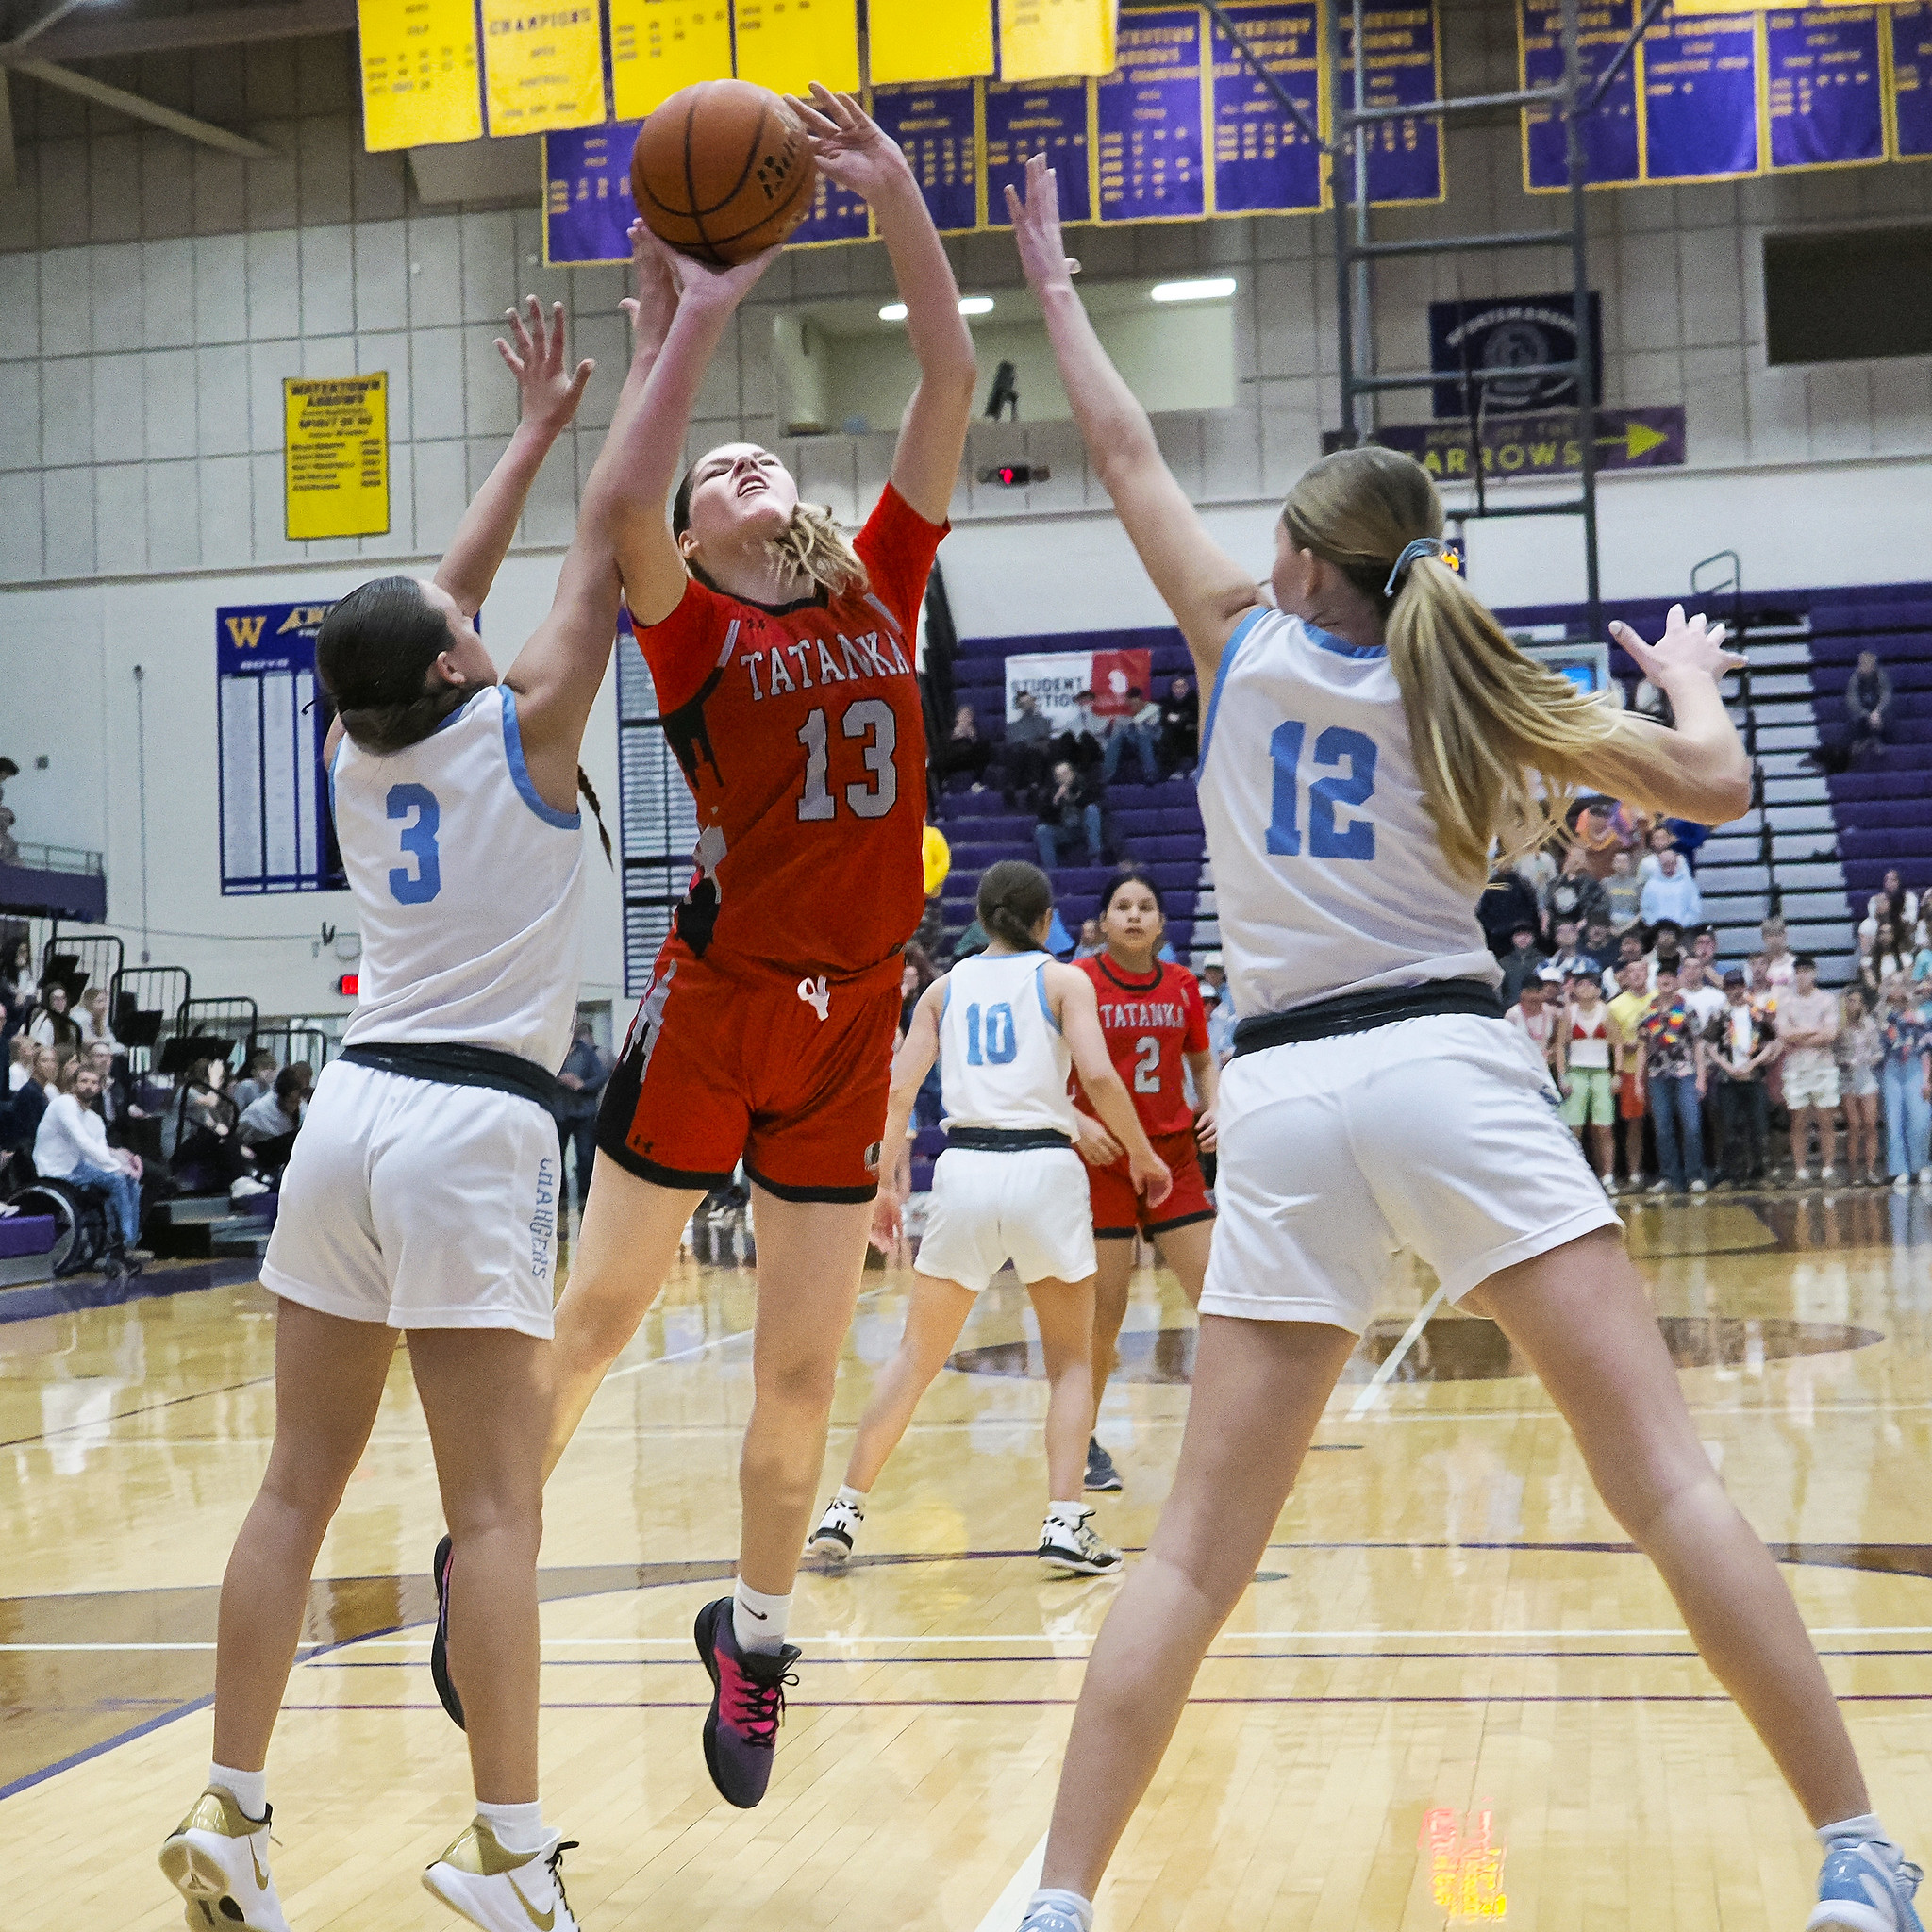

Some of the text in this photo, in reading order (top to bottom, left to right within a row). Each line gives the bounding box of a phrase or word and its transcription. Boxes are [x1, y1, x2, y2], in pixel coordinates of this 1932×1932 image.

[490, 8, 591, 36] CHAMPIONS
[225, 616, 267, 649] W
[740, 631, 910, 700] TATANKA
[797, 698, 896, 821] 13
[1265, 720, 1379, 861] 12
[386, 782, 441, 906] 3
[966, 1002, 1016, 1065] 10
[1100, 1003, 1185, 1029] TATANKA
[1134, 1036, 1161, 1093] 2
